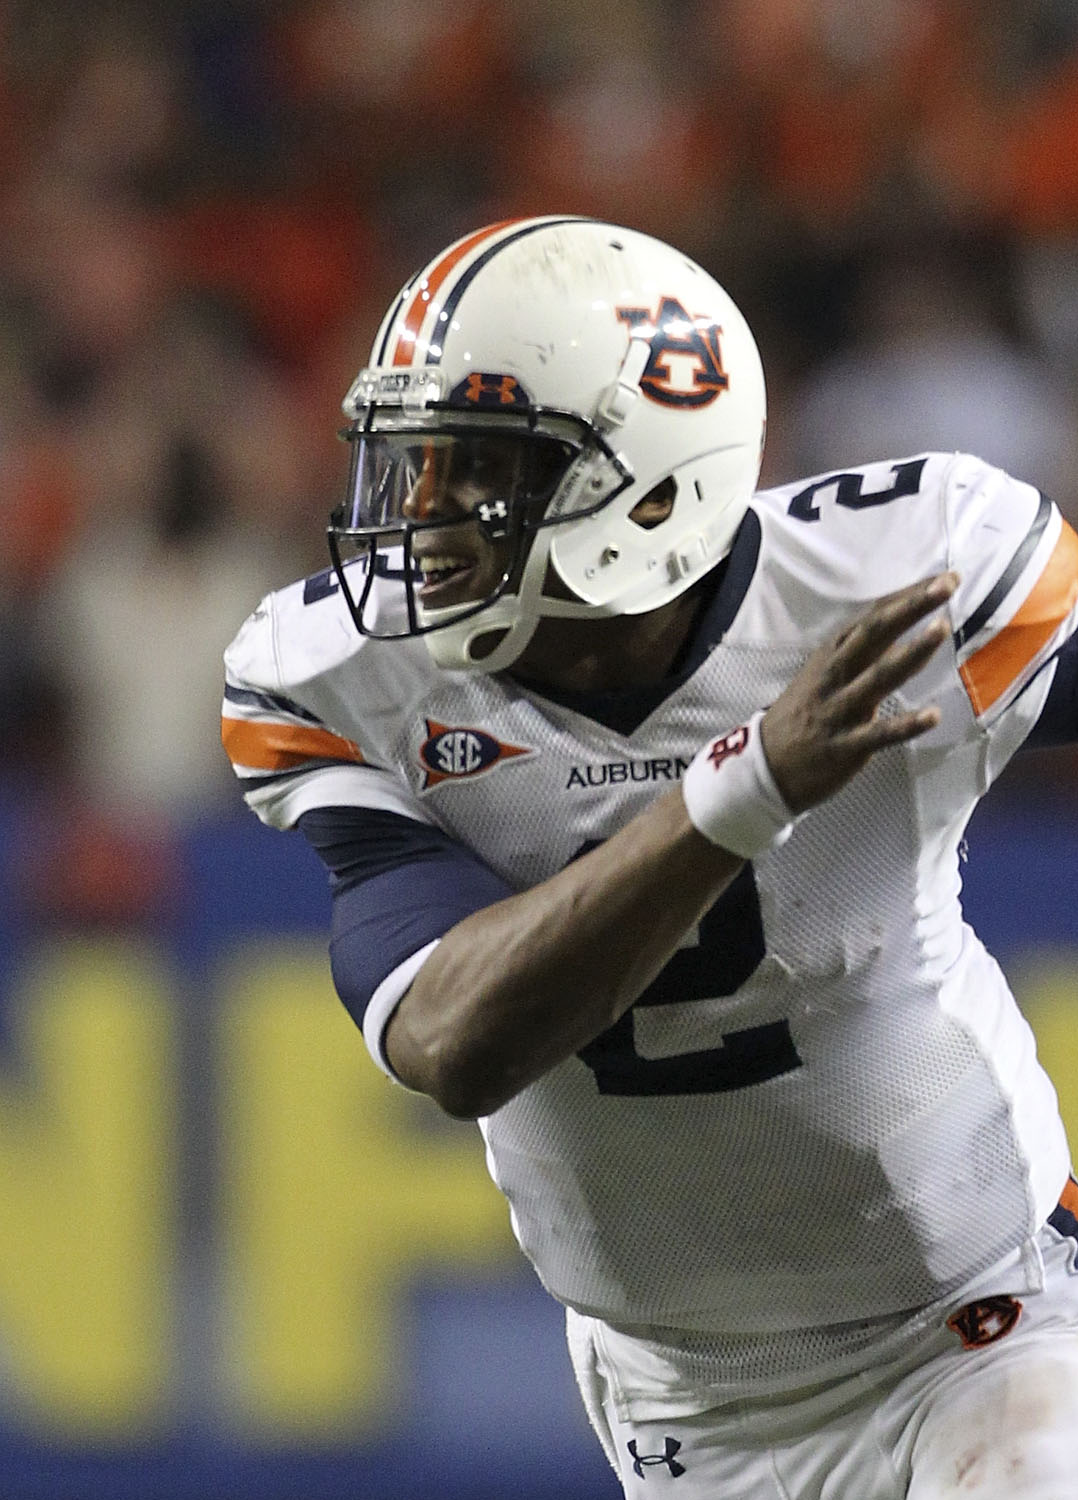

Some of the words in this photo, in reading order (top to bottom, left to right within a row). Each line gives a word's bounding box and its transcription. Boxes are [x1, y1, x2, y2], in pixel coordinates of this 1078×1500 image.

[786, 458, 929, 522] 2
[436, 731, 482, 774] SEC
[565, 755, 696, 789] AUBURN
